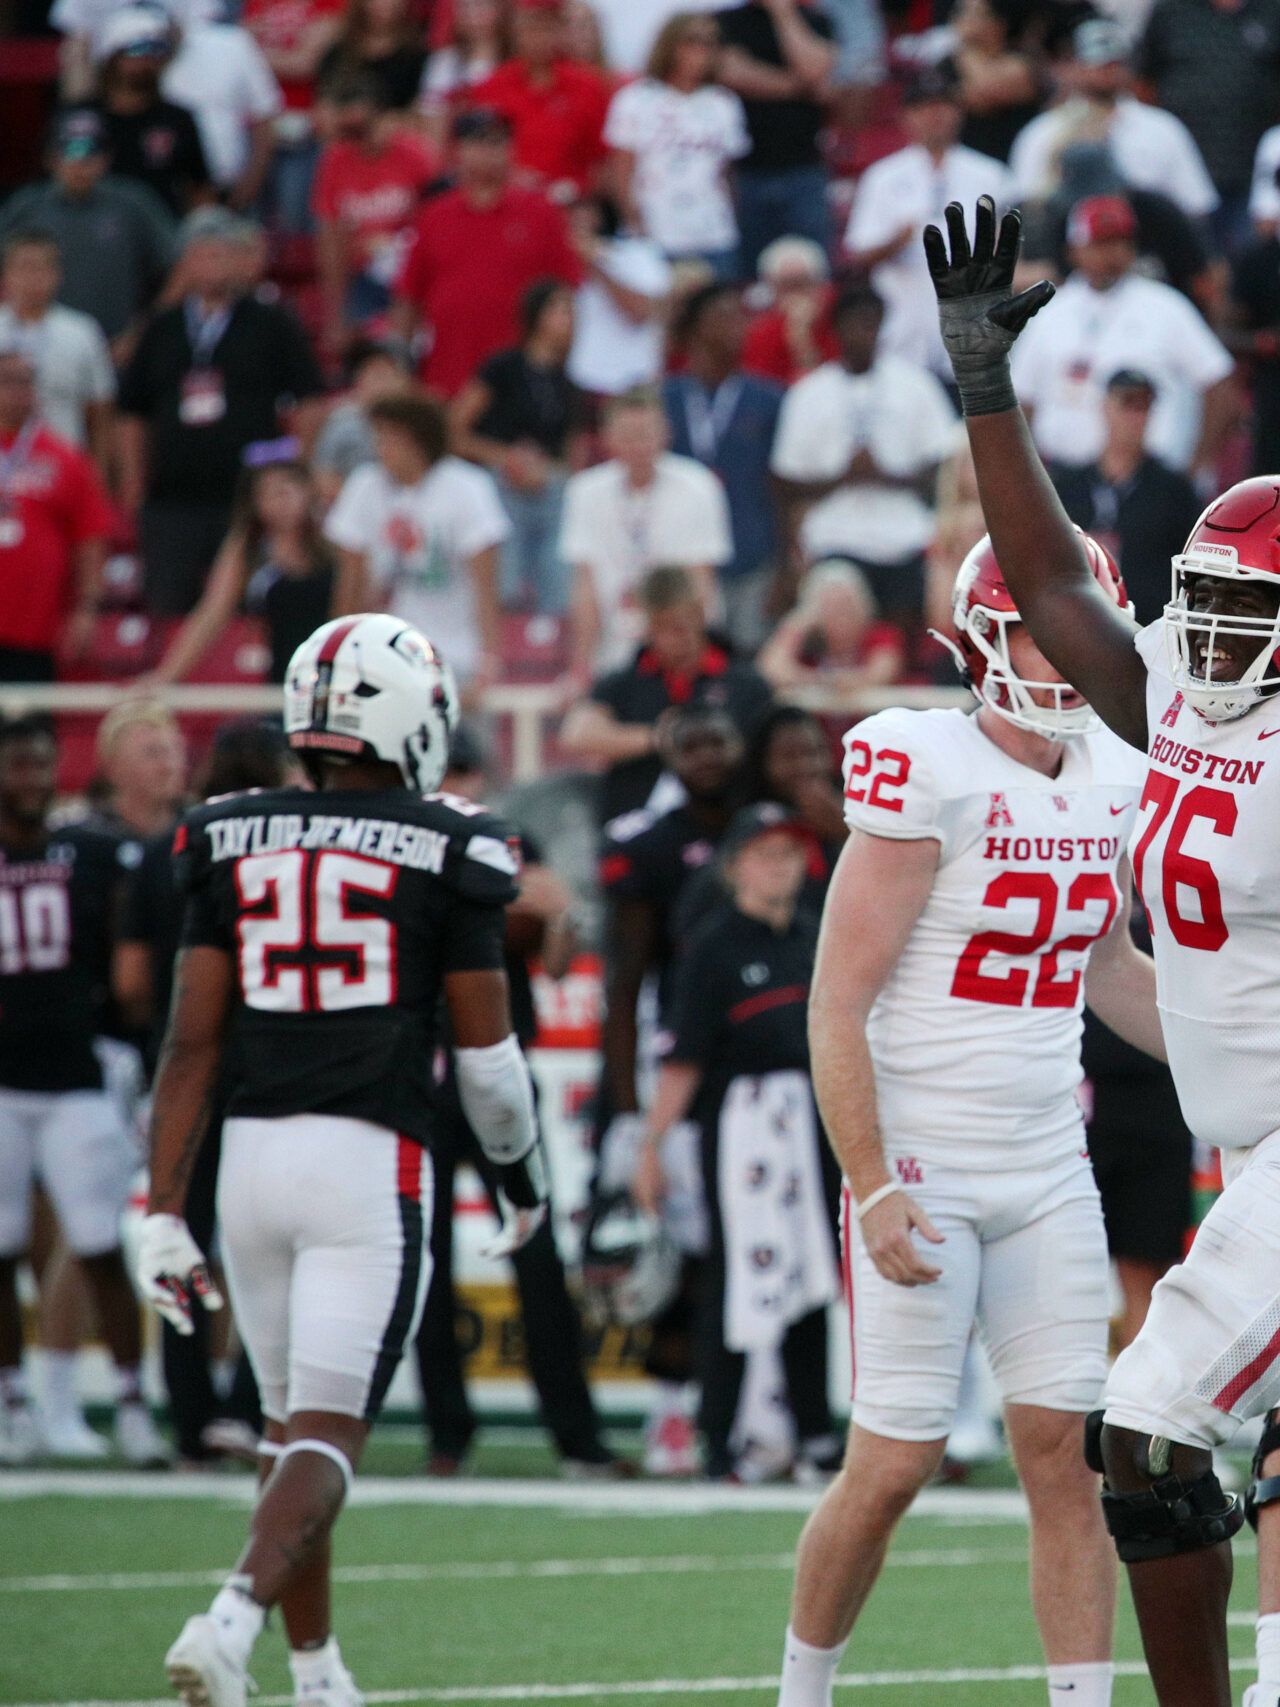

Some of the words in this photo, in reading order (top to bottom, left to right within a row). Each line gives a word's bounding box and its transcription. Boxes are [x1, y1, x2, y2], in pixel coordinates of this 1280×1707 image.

[1193, 544, 1232, 557] HOUSTON
[844, 740, 912, 814] 22
[1149, 733, 1266, 785] HOUSTON
[1132, 768, 1239, 952] 76
[0, 880, 70, 974] 10
[233, 847, 400, 1013] 25
[949, 871, 1120, 1009] 22
